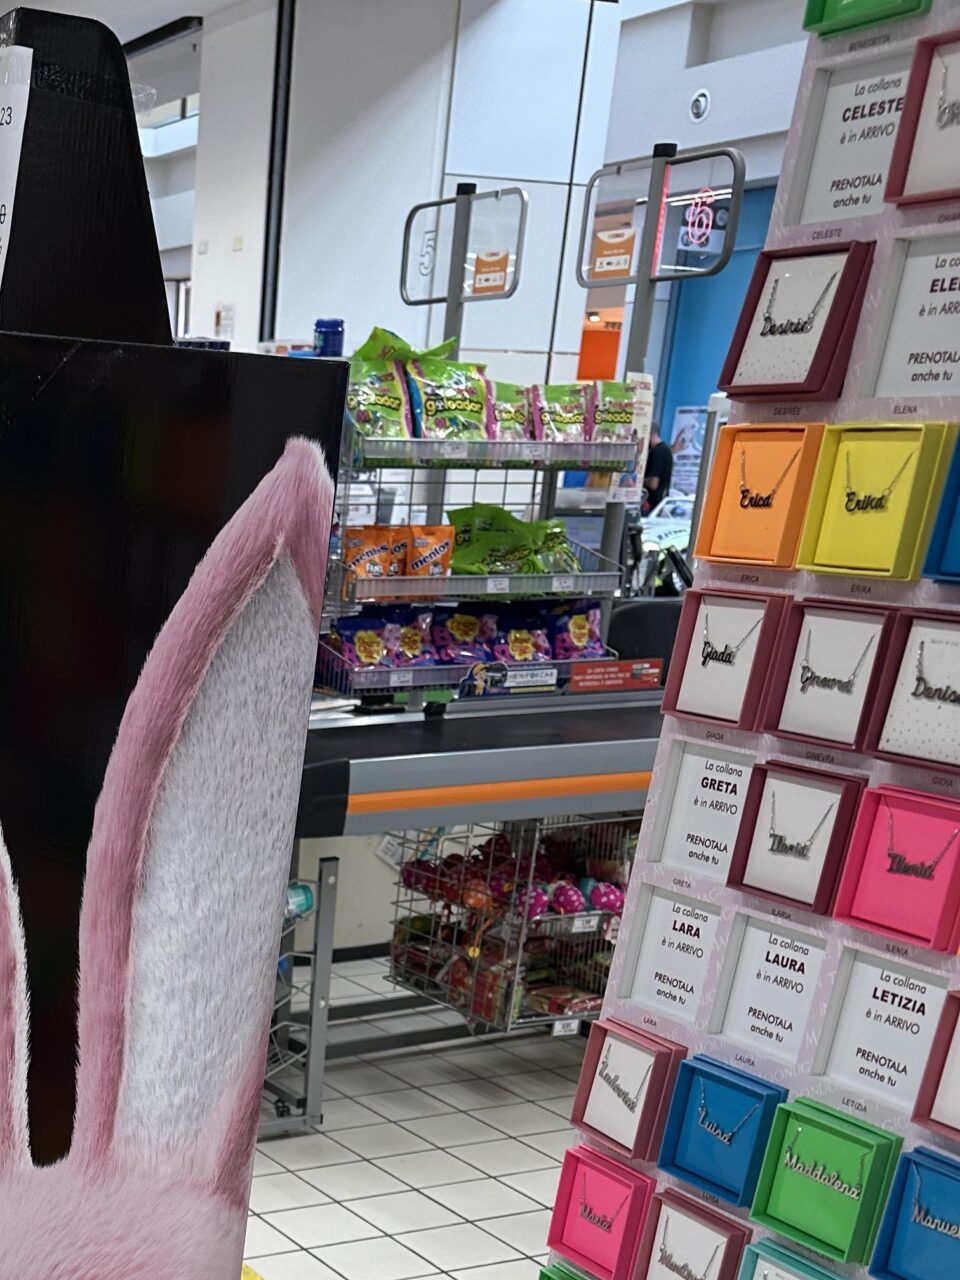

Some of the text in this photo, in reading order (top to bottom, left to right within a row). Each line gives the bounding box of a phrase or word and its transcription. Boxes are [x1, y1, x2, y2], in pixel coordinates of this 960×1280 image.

[855, 77, 902, 97] La collana
[842, 96, 906, 122] CELESTE
[848, 129, 858, 143] in
[858, 122, 896, 141] ARRIVO
[830, 173, 883, 192] PRENOTALA
[833, 193, 872, 209] anche tu
[811, 227, 843, 241] CELESTE
[419, 231, 437, 277] 5
[935, 256, 946, 269] La
[930, 278, 960, 293] ELE
[927, 302, 938, 316] in
[911, 367, 953, 382] anche tu
[593, 409, 634, 426] goleado
[893, 404, 918, 416] ELENA
[740, 488, 772, 509] Erica
[845, 491, 886, 513] Erika
[410, 540, 451, 571] mentos
[741, 574, 760, 584] ERICA
[702, 640, 734, 667] Giada
[805, 751, 835, 764] GINEVRA
[705, 760, 743, 777] La collana
[701, 777, 738, 795] GRETA
[700, 797, 707, 808] in
[709, 800, 738, 815] ARRIVO
[686, 833, 728, 853] PRENOTALA
[688, 850, 719, 865] anche tu
[672, 878, 691, 889] GRETA
[672, 903, 708, 923] La collana
[672, 920, 701, 939] LARA
[667, 939, 675, 948] in
[675, 942, 704, 959] ARRIVO
[768, 933, 809, 956] La collana
[765, 951, 805, 975] LAURA
[654, 971, 695, 995] PRENOTALA
[763, 972, 771, 982] in
[772, 975, 804, 994] ARRIVO
[880, 969, 927, 995] La collana
[656, 988, 686, 1005] anche tu
[872, 987, 926, 1016] LETIZIA
[643, 1016, 657, 1028] LARA
[748, 1007, 793, 1032] PRENOTALA
[873, 1010, 882, 1022] in
[883, 1014, 920, 1035] ARRIVO
[750, 1025, 784, 1043] anche tu
[735, 1053, 756, 1068] LAURA
[856, 1047, 908, 1076] PRENOTALA
[859, 1066, 897, 1087] anche tu
[842, 1096, 868, 1113] LETIZIA
[699, 1106, 733, 1146] Luisa
[784, 1150, 861, 1201] Maddalena
